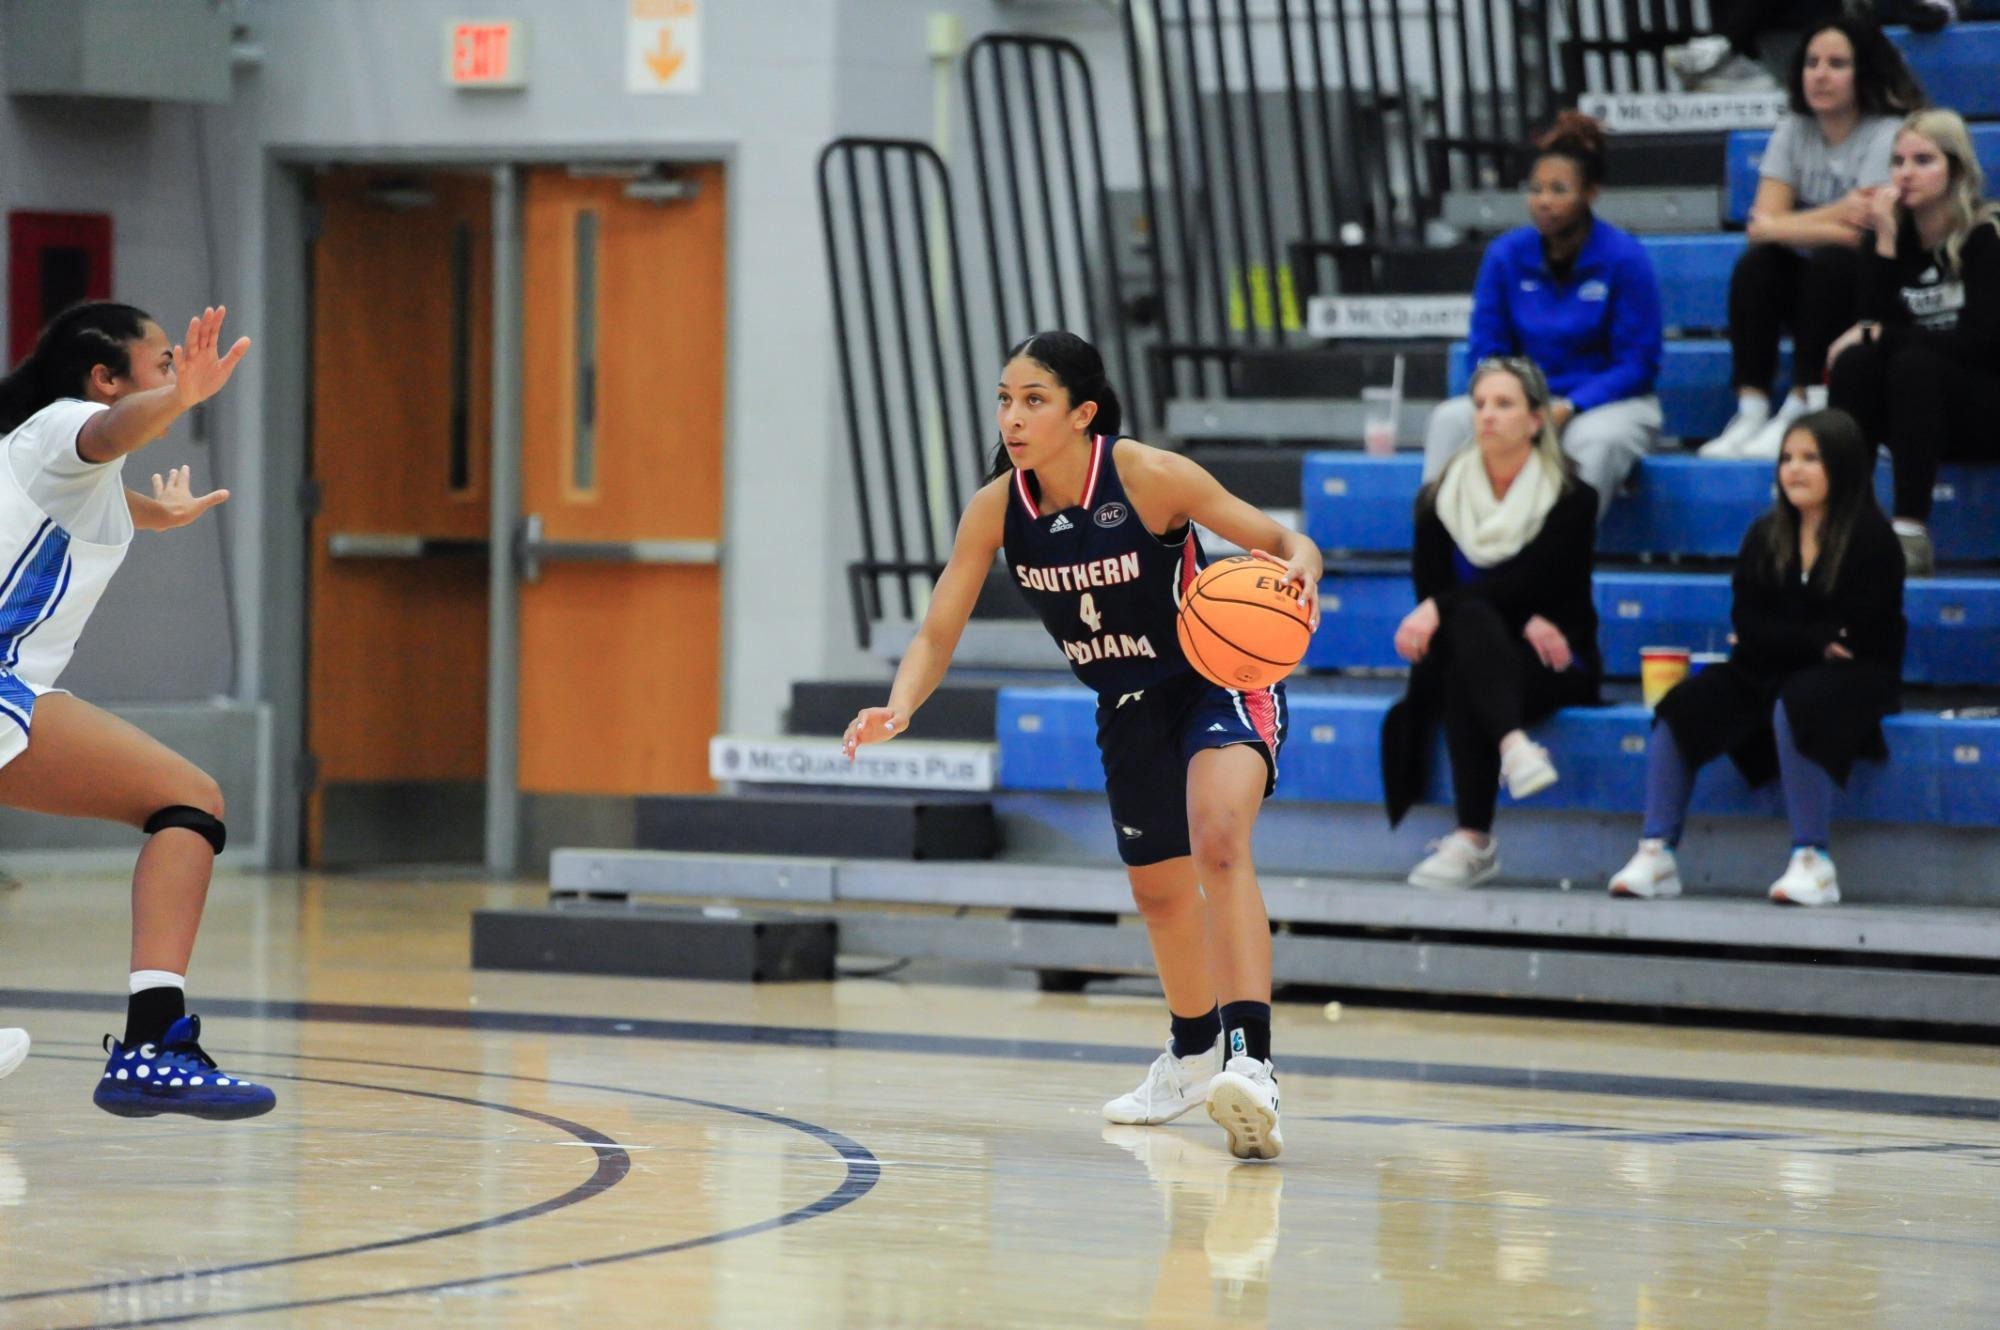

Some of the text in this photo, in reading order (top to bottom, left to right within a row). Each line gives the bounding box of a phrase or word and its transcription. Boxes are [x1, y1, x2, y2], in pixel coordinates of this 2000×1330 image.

[454, 24, 509, 81] EXIT
[1049, 522, 1074, 534] adidas
[1101, 509, 1119, 521] OVC
[1016, 551, 1140, 592] SOUTHERN
[1080, 592, 1102, 633] 4
[1062, 634, 1157, 665] INDIANA
